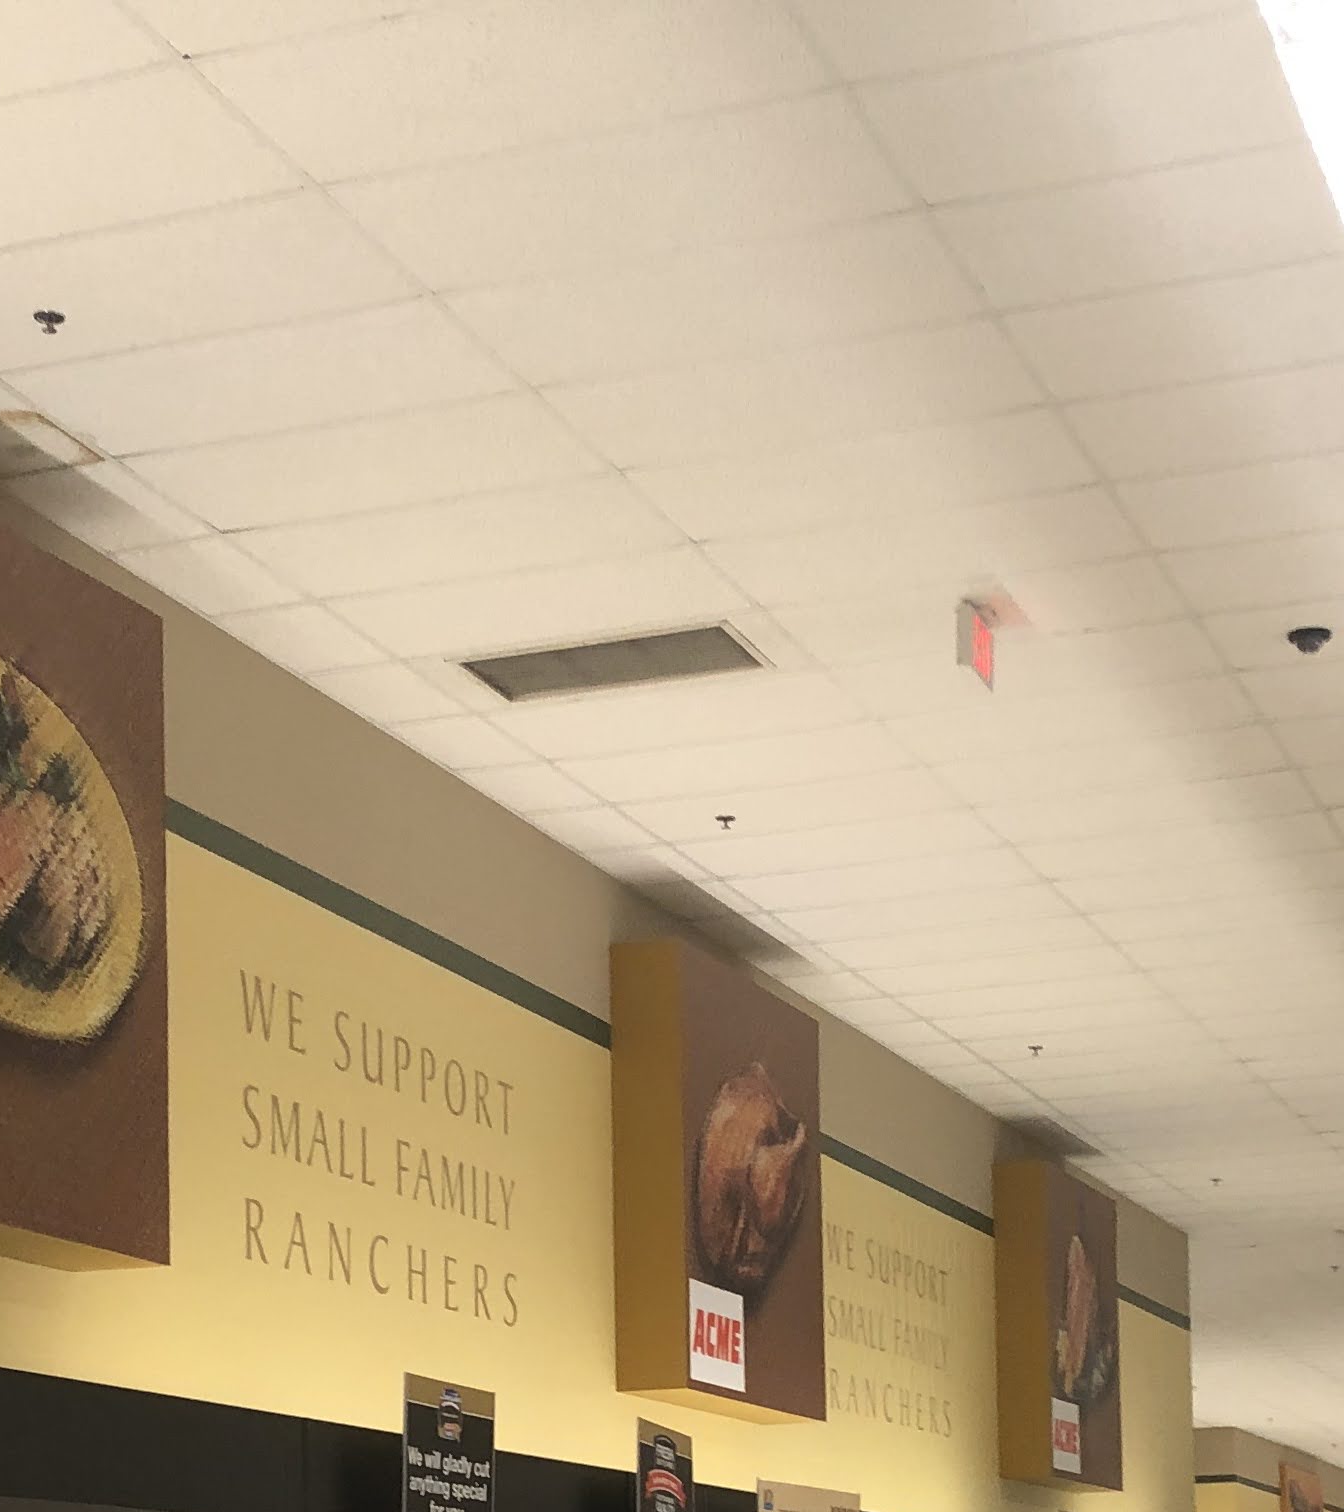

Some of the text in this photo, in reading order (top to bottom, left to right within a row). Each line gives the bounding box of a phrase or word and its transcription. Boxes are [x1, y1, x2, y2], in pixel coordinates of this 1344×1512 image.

[240, 969, 515, 1136] WE SUPPORT
[241, 1085, 517, 1231] SMALL FAMILY
[243, 1197, 520, 1328] RANCHERS
[826, 1223, 948, 1307] WE SUPPORT
[692, 1307, 742, 1366] ACME
[827, 1295, 886, 1352] SMALL
[829, 1368, 953, 1438] RANCHERS
[407, 1445, 491, 1479] We will gladly cut
[409, 1474, 488, 1502] anything special
